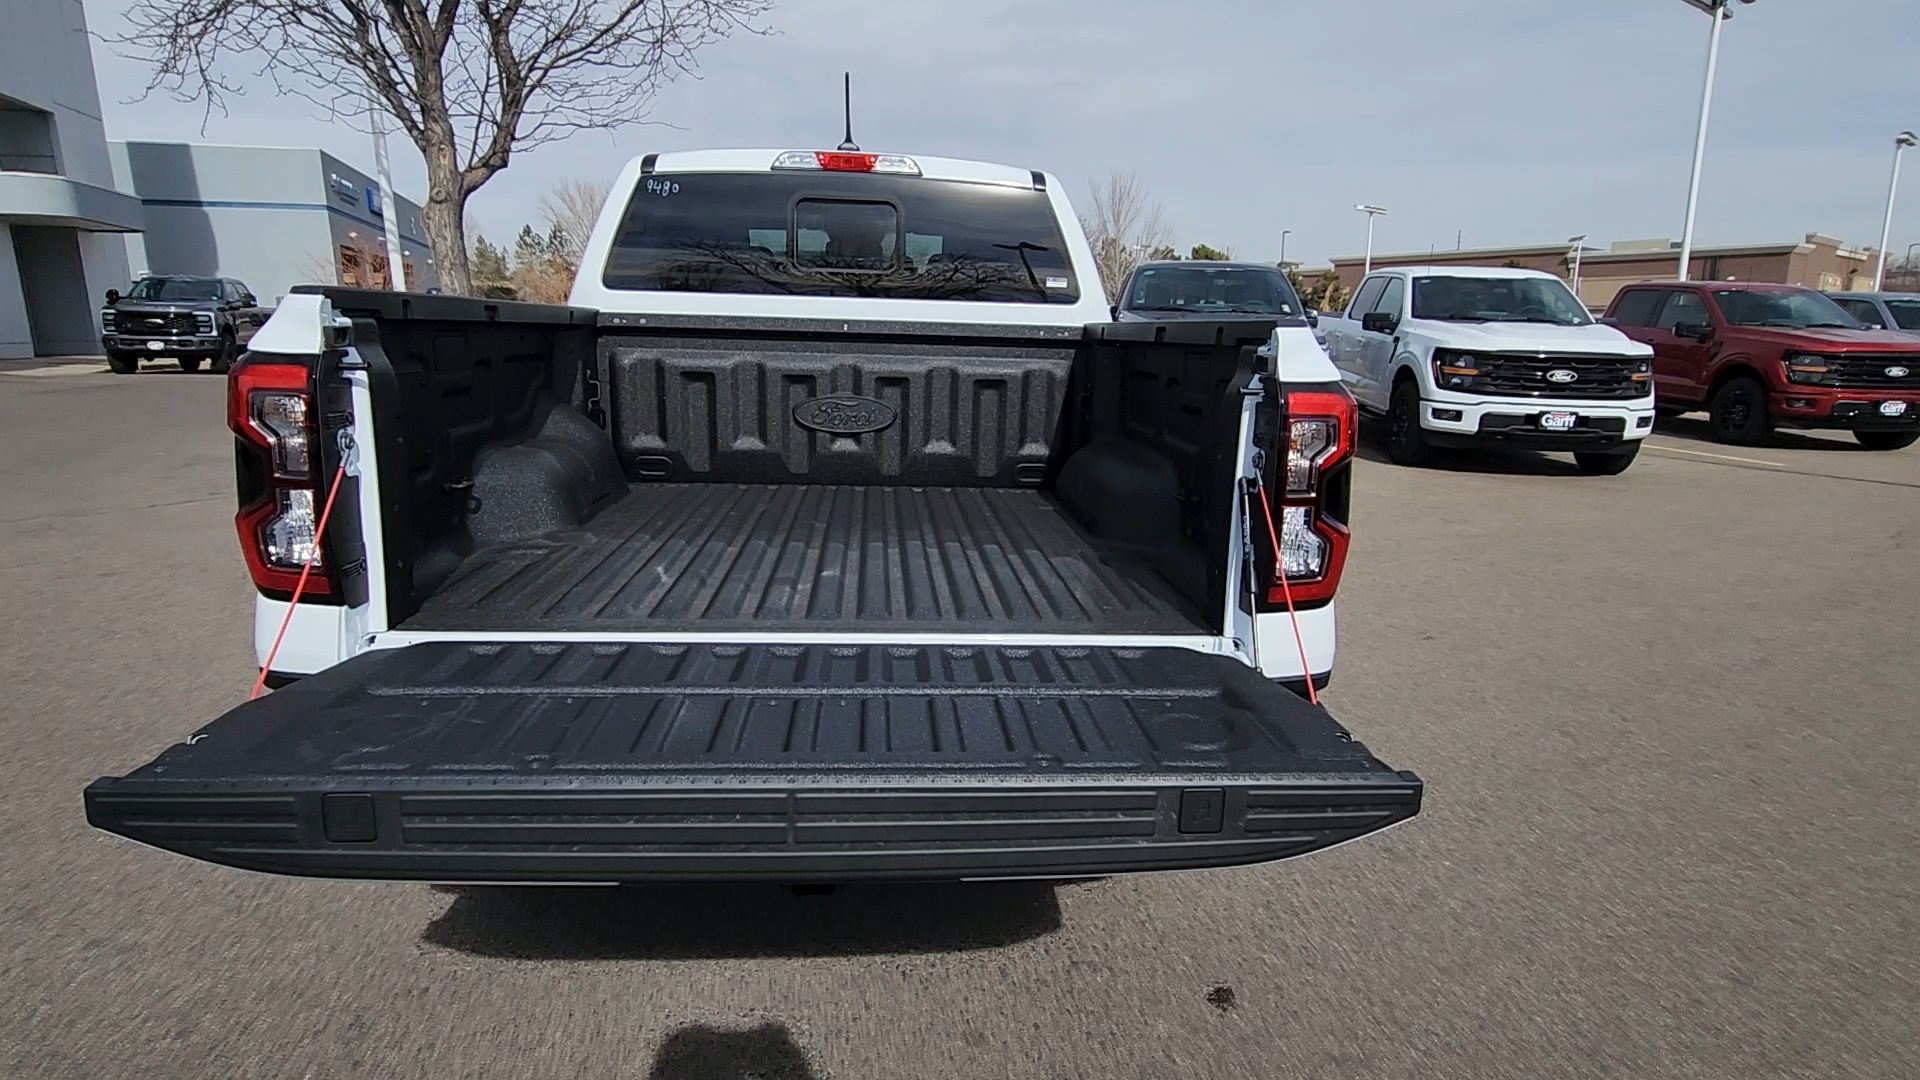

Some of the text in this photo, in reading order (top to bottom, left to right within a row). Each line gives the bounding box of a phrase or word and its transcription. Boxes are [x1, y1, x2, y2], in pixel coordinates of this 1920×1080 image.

[646, 178, 680, 197] 9480
[1550, 370, 1575, 382] Ford
[811, 401, 876, 426] Ford
[1541, 413, 1577, 428] Garff
